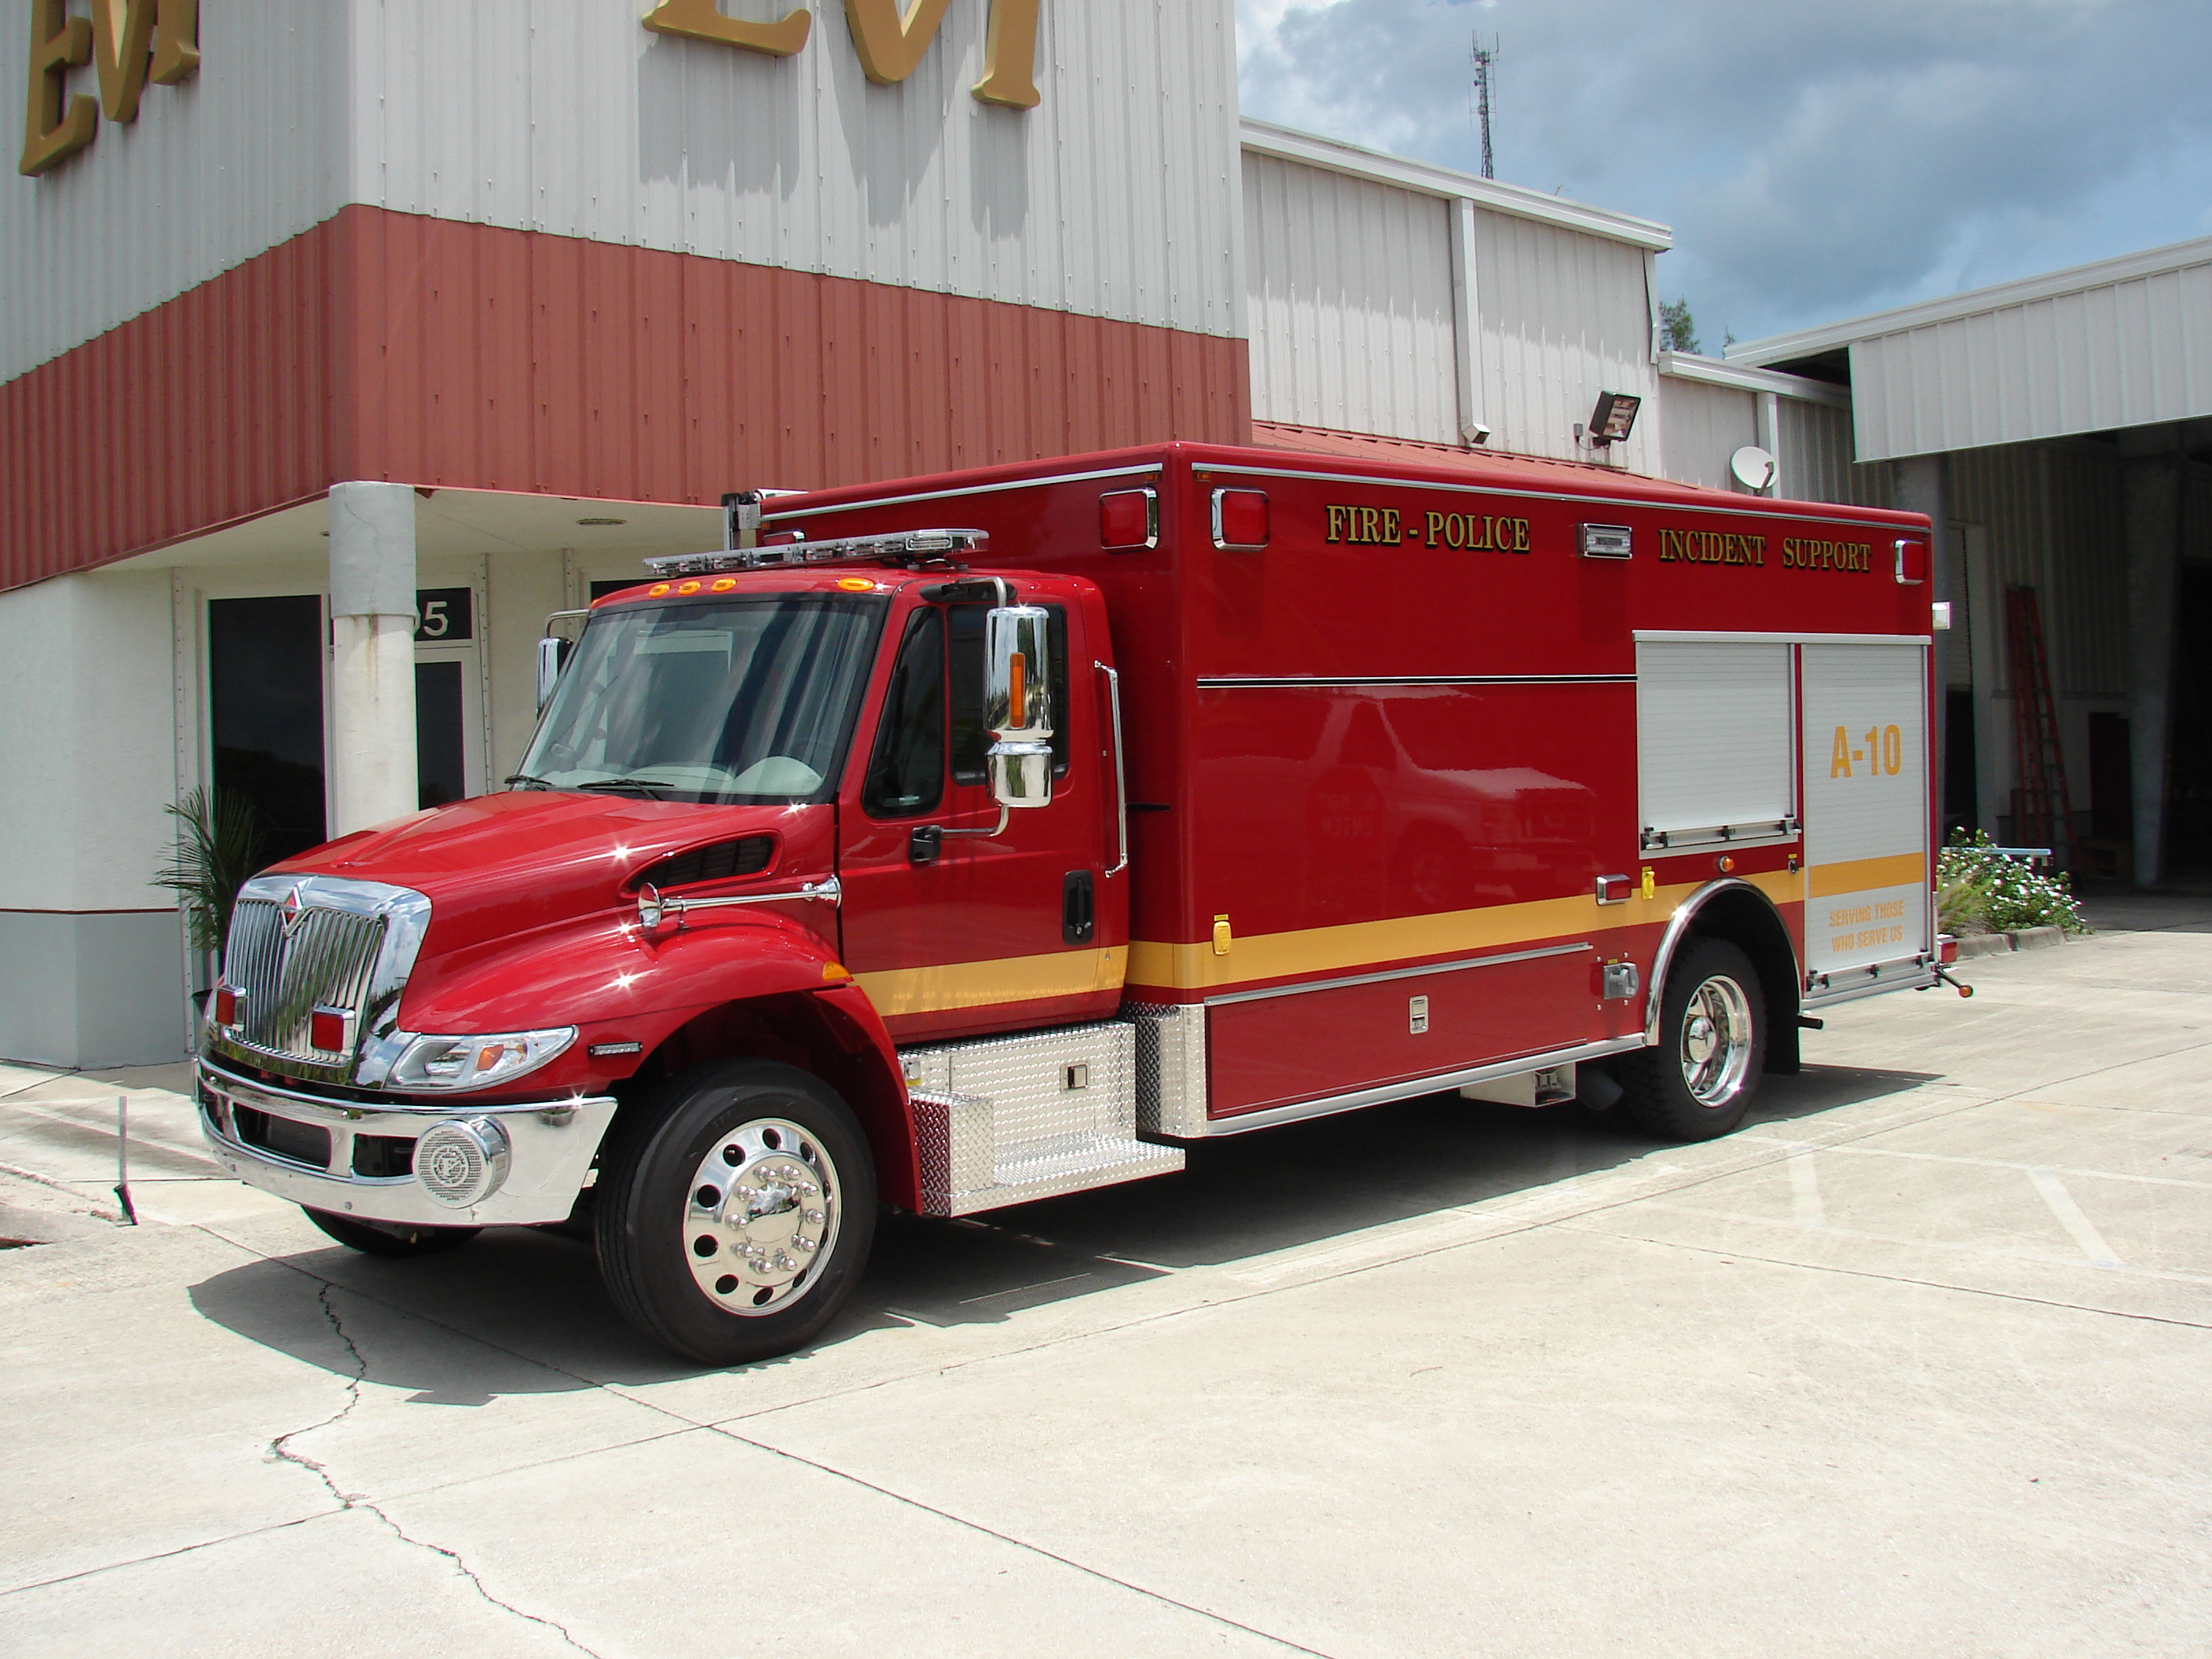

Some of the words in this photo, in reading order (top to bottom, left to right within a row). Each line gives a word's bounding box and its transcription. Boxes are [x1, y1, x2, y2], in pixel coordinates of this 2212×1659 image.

[1326, 504, 1401, 544] FIRE
[1424, 511, 1530, 552] POLICE
[1658, 529, 1766, 566] INCIDENT
[1782, 537, 1871, 572] SUPPORT
[415, 600, 449, 636] 5
[1829, 724, 1902, 778] A-10
[1829, 906, 1872, 928] SERVING
[1874, 900, 1904, 920] THOSE
[1832, 932, 1855, 953] WHO
[1857, 928, 1888, 948] SERVE
[1890, 925, 1903, 942] US
